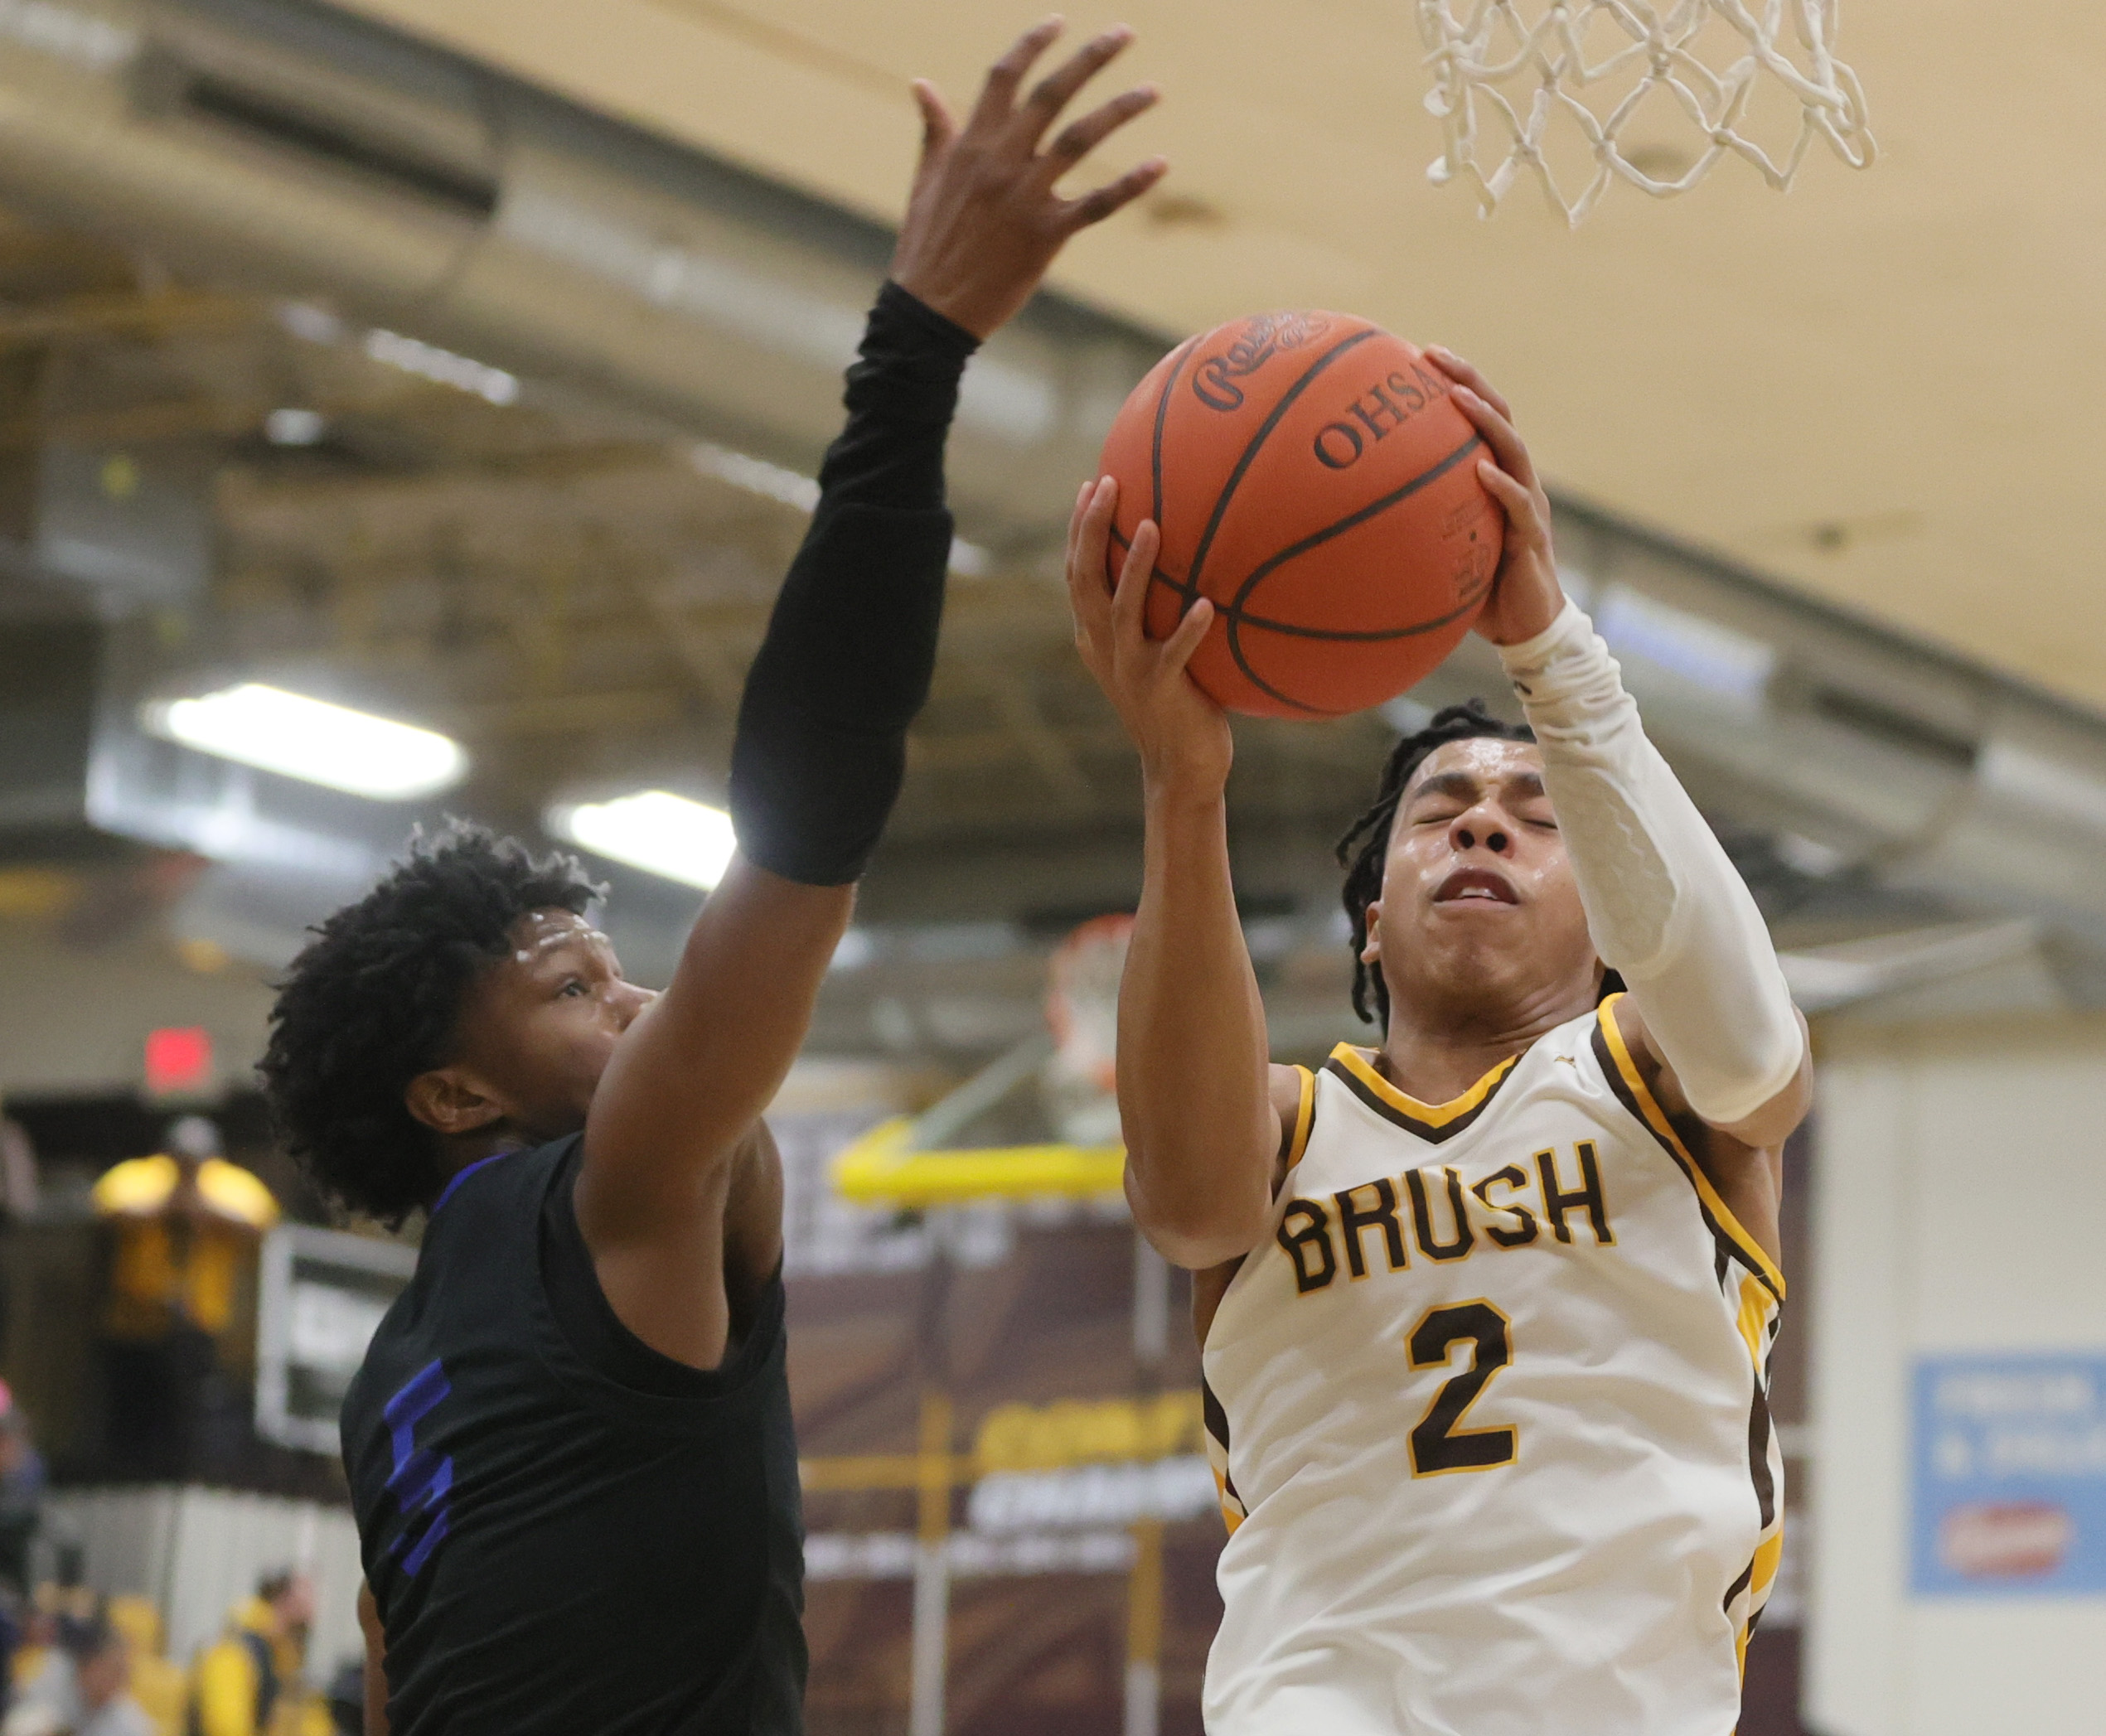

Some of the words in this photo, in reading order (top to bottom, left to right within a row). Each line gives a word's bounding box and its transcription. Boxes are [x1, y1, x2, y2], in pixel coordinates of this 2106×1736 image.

[1314, 362, 1447, 471] OHSA
[1276, 1139, 1617, 1298] BRUSH
[1403, 1296, 1518, 1479] 2
